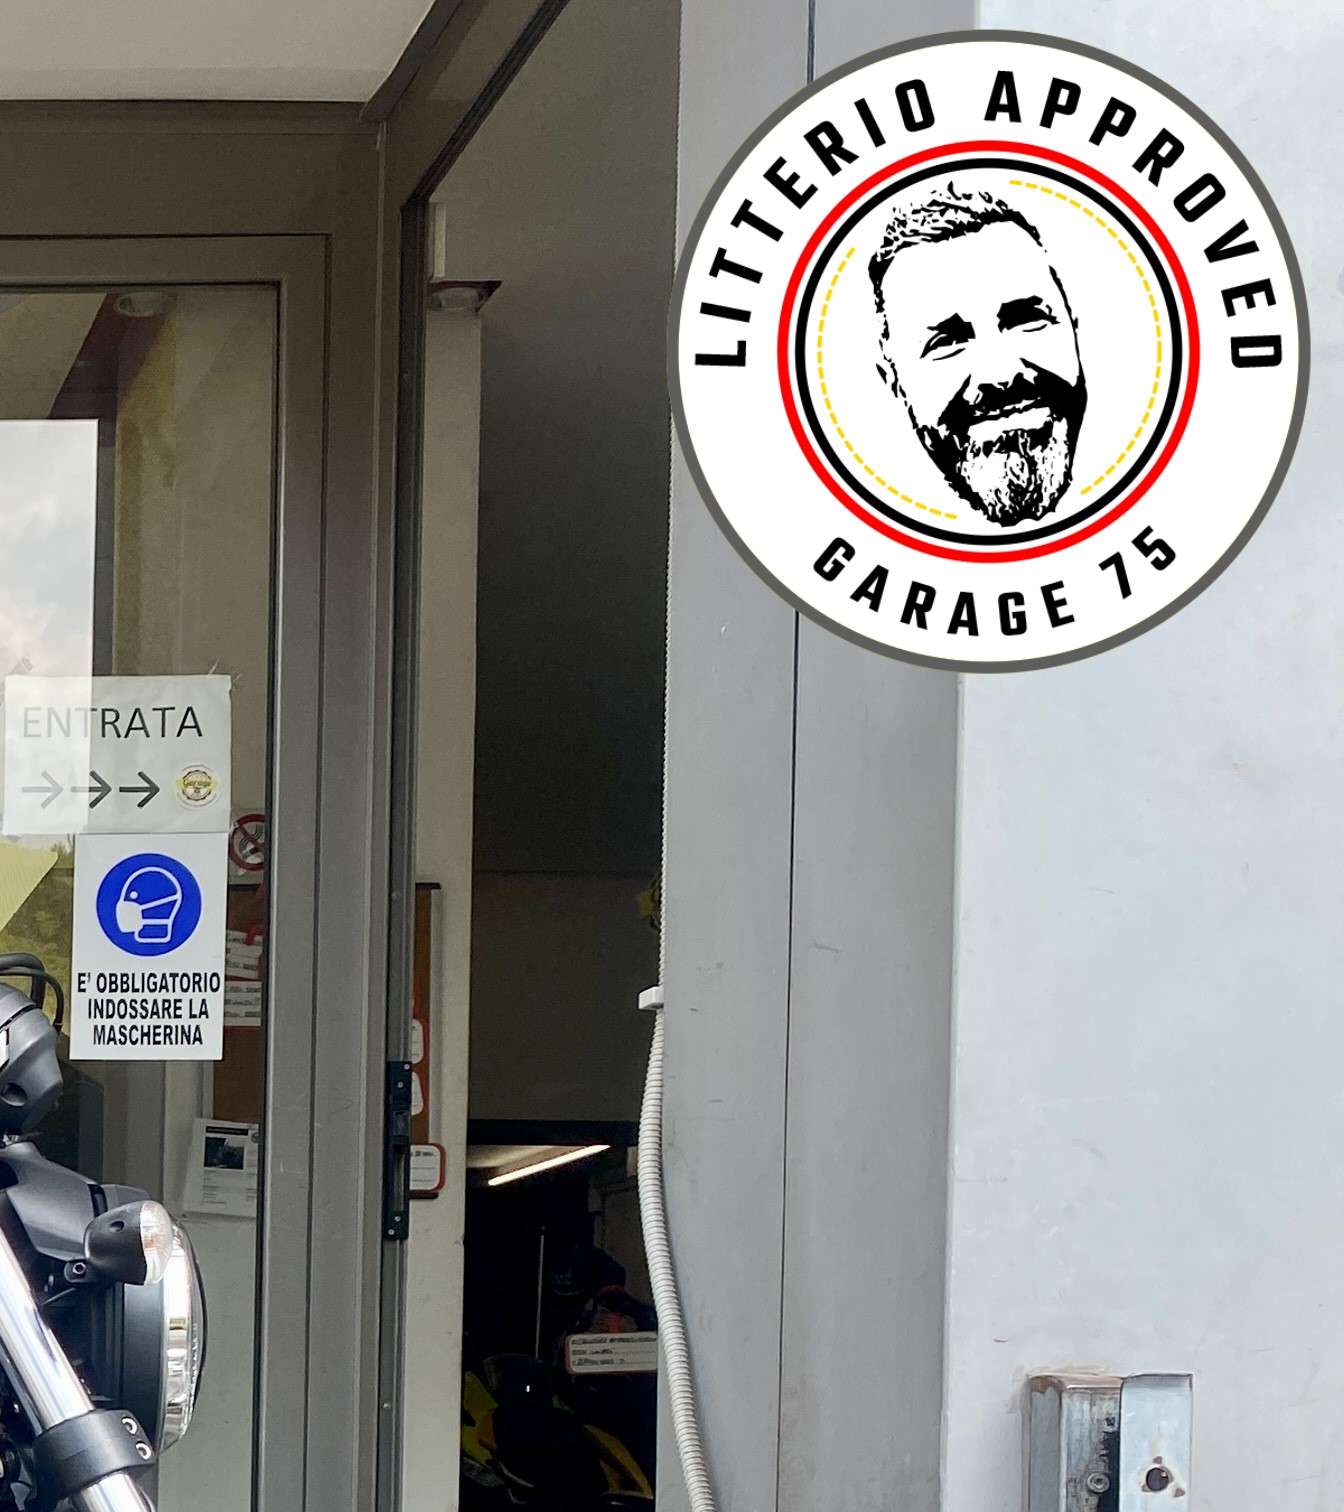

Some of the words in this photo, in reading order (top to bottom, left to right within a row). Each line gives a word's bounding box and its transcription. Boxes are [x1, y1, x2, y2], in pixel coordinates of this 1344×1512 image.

[23, 705, 203, 739] ENTRATA
[96, 971, 221, 994] OBBLIGATORIO
[87, 998, 184, 1019] INDOSSARE
[188, 998, 210, 1019] LA
[92, 1023, 204, 1046] MASCHERINA
